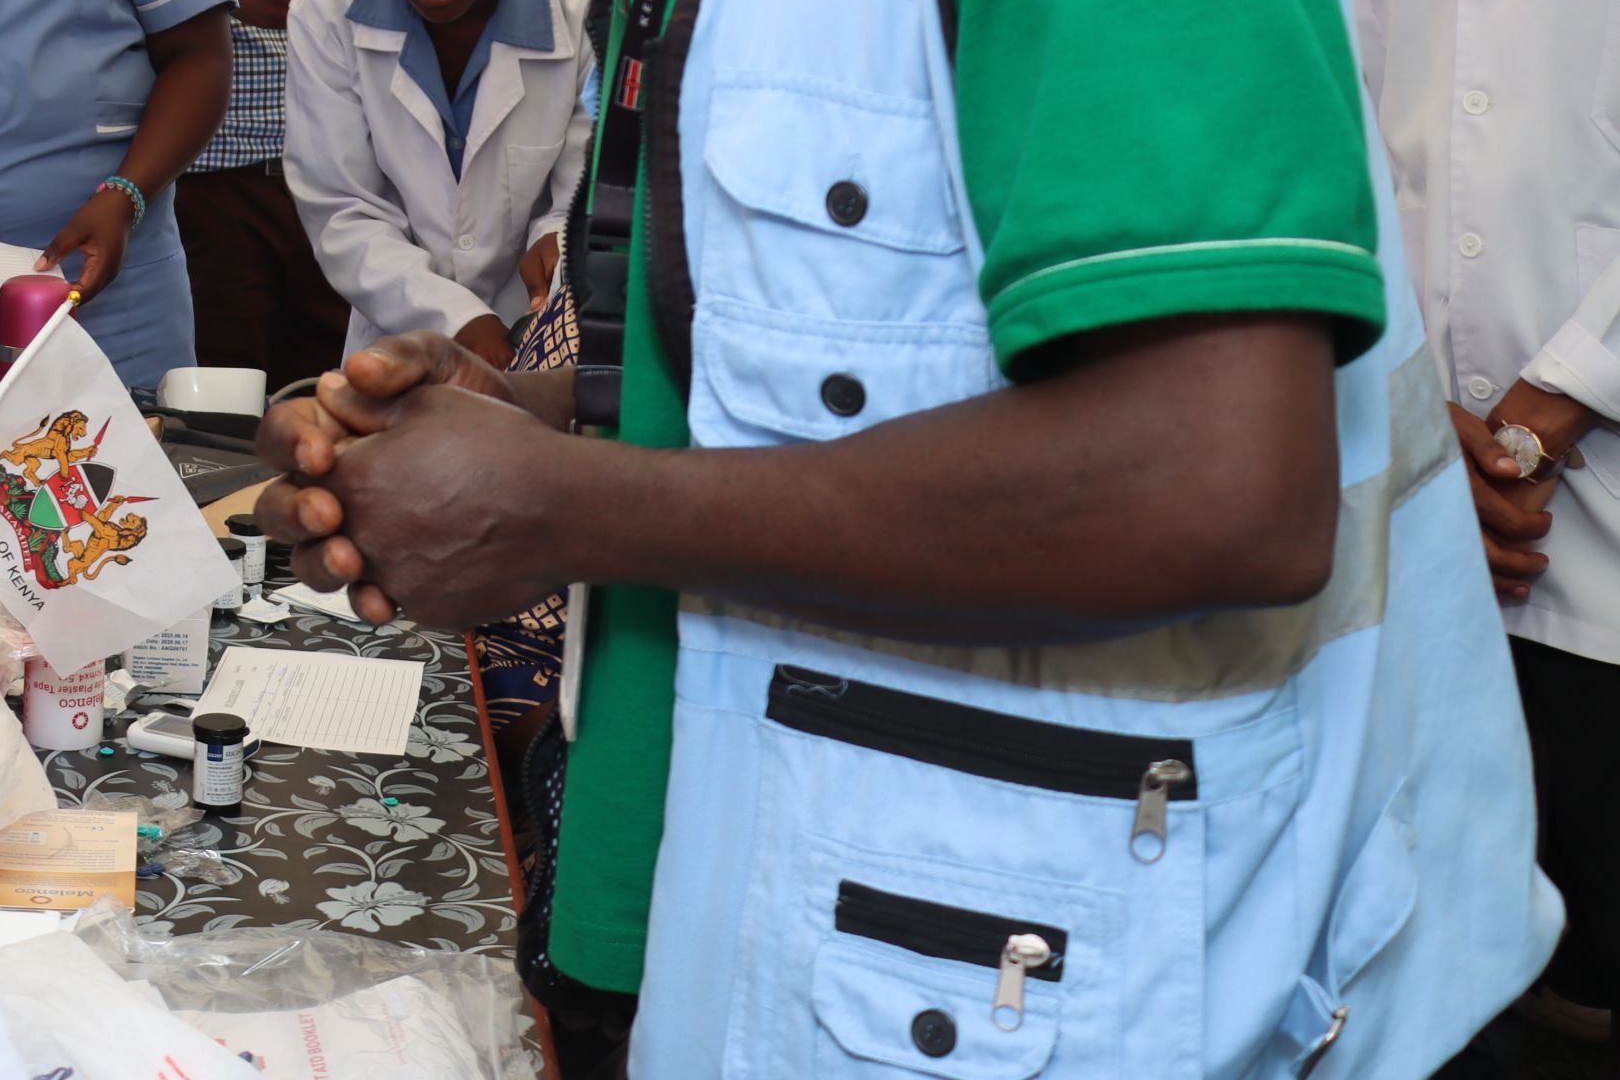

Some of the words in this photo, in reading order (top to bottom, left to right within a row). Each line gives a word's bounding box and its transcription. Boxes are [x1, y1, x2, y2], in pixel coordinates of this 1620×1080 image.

[7, 565, 45, 611] KENYA
[33, 681, 55, 694] Tape
[58, 681, 93, 693] Plaster
[15, 887, 93, 897] Melenco
[299, 1012, 323, 1055] BOOKLET
[309, 1055, 331, 1072] AID
